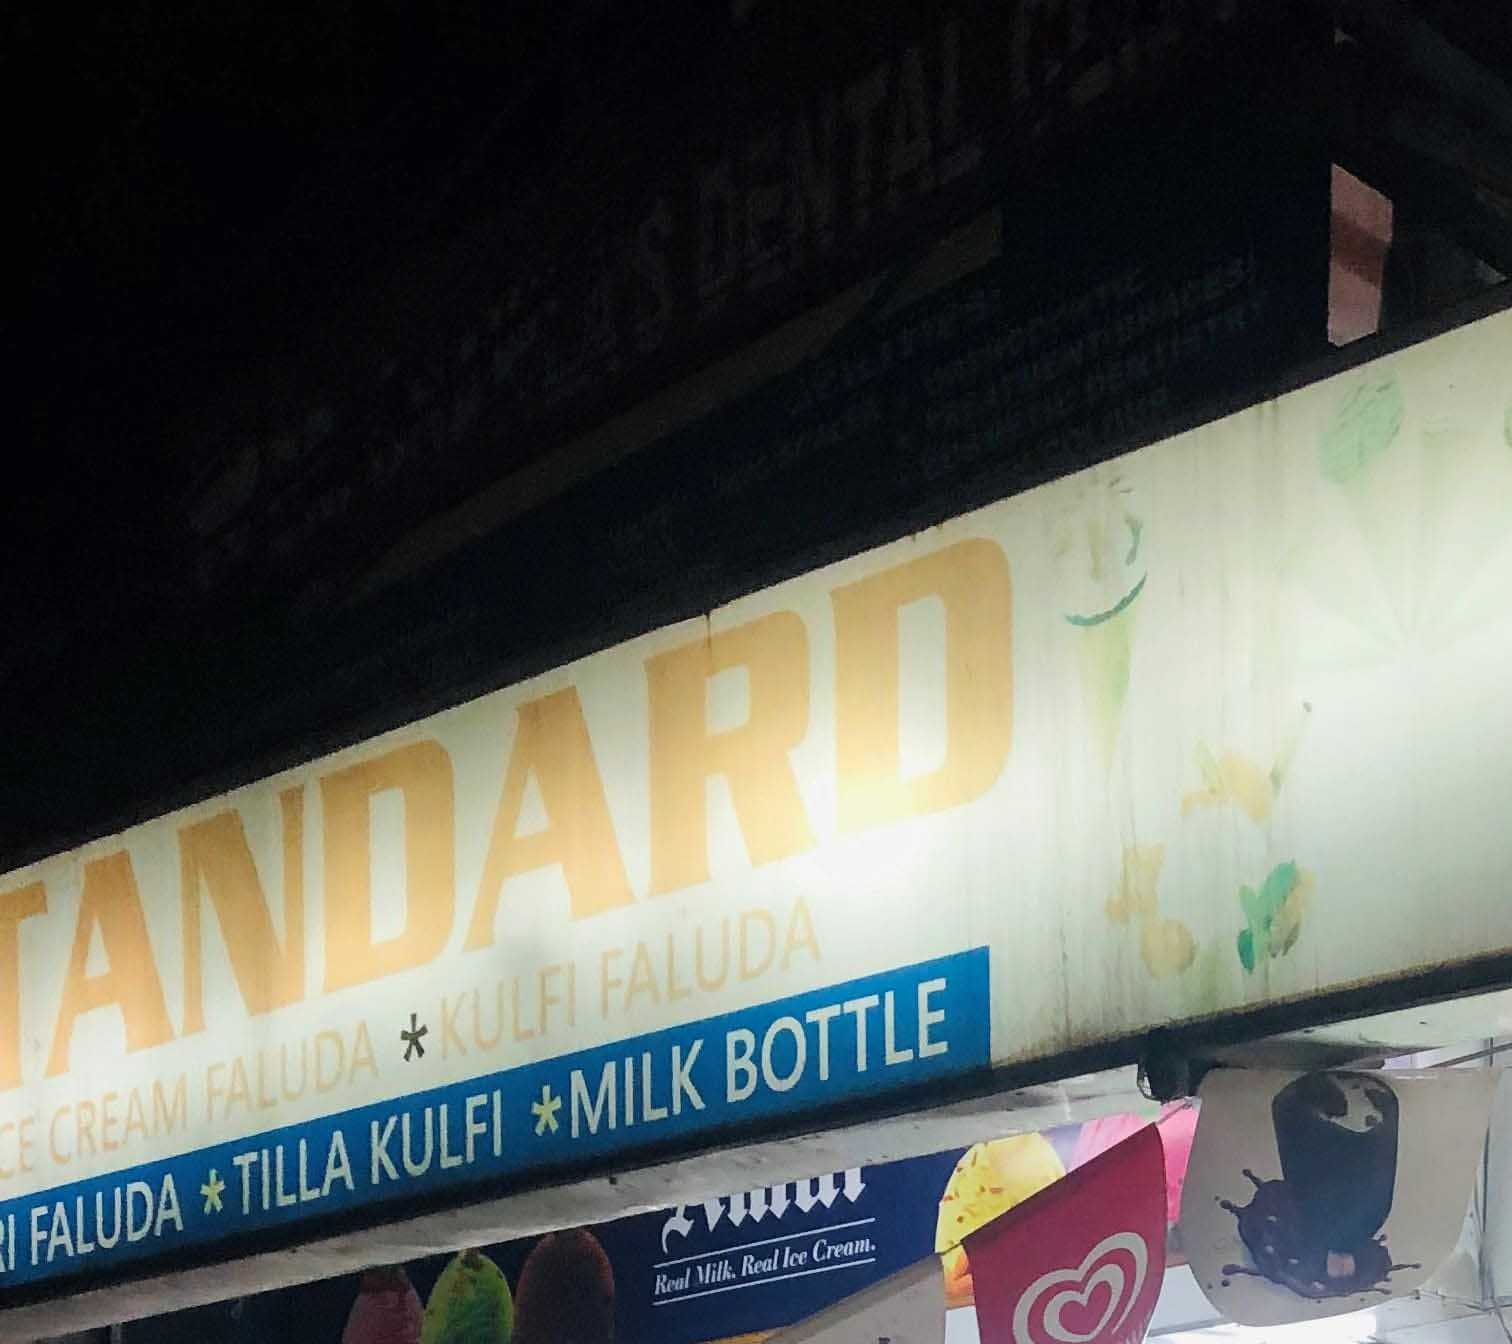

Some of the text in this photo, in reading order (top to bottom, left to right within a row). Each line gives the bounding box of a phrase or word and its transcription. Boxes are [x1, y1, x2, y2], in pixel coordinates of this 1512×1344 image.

[31, 1172, 184, 1267] FALUDA
[232, 1130, 354, 1215] TILLA
[371, 1091, 502, 1197] KULFI
[570, 1040, 705, 1139] MILK
[726, 977, 949, 1103] BOTTLE
[49, 1072, 189, 1165] CREAM
[206, 1028, 378, 1121] FALUDA
[440, 965, 577, 1061] KULFI
[600, 896, 822, 1019] FALUDA
[655, 1266, 690, 1295] Real
[742, 1249, 778, 1276] Real
[783, 1245, 807, 1269] Ice
[813, 1237, 876, 1263] Cream.
